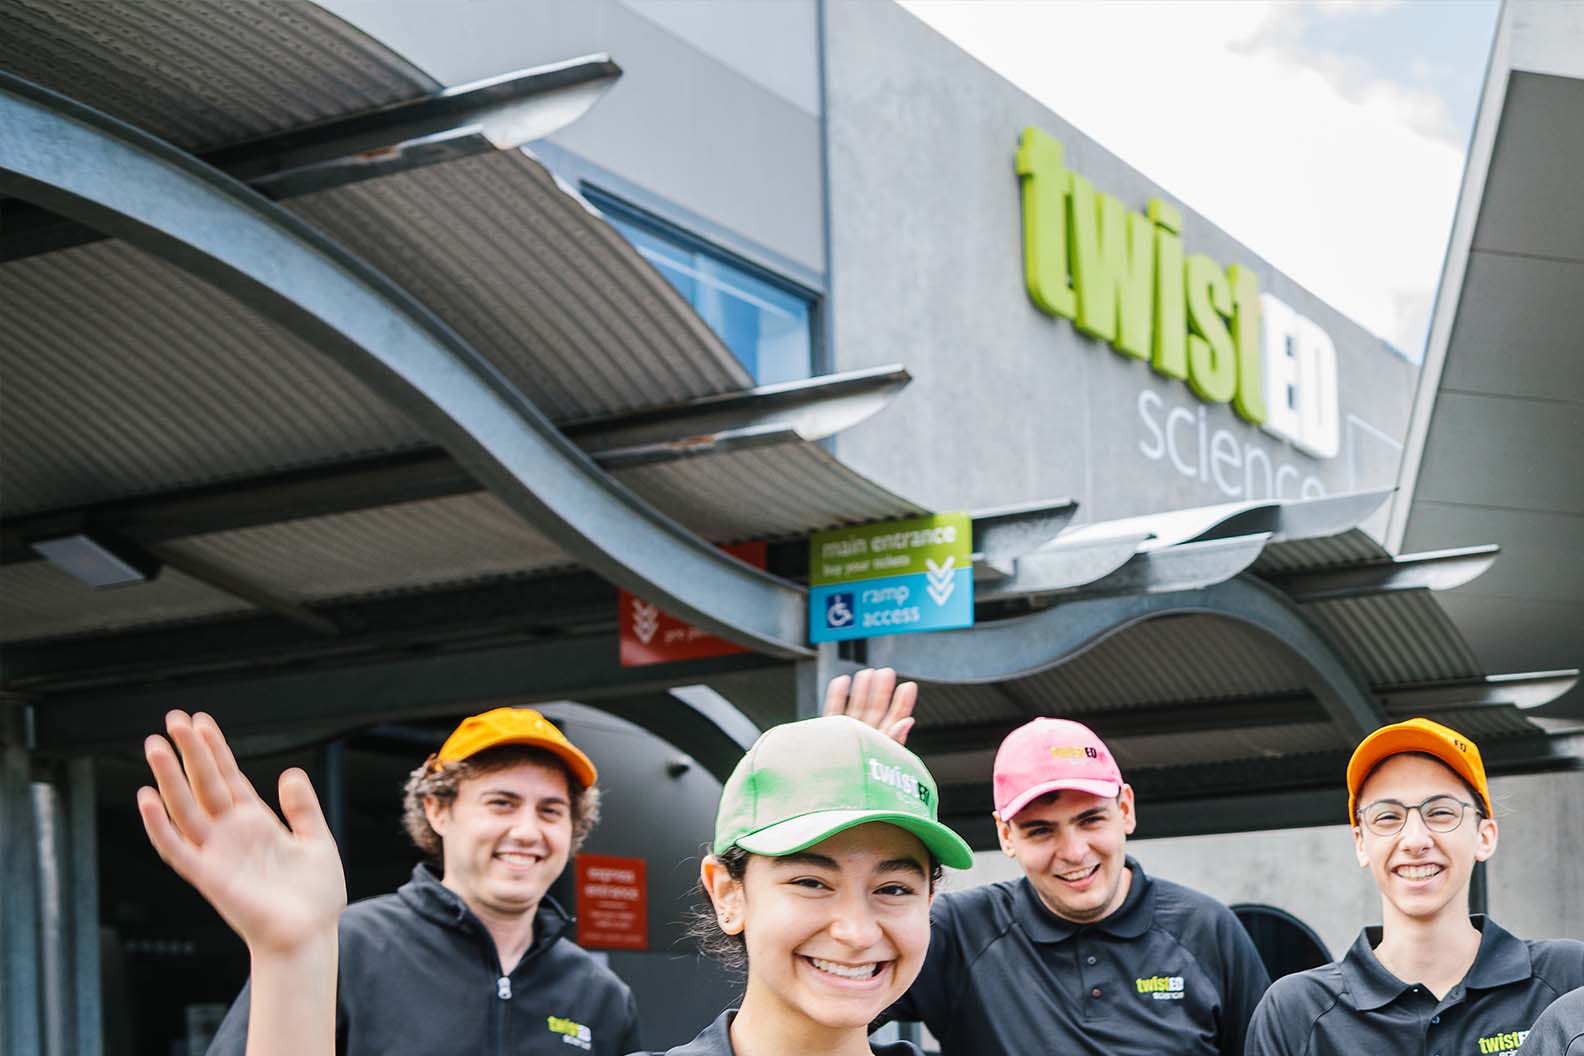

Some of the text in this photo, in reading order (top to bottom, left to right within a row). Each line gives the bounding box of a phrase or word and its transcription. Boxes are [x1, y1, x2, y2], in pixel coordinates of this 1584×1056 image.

[1016, 125, 1340, 460] twistED
[822, 526, 957, 558] main entrance
[863, 586, 909, 606] ramp
[863, 607, 920, 628] access
[1135, 976, 1184, 993] twistED
[1478, 1030, 1531, 1055] twistE
